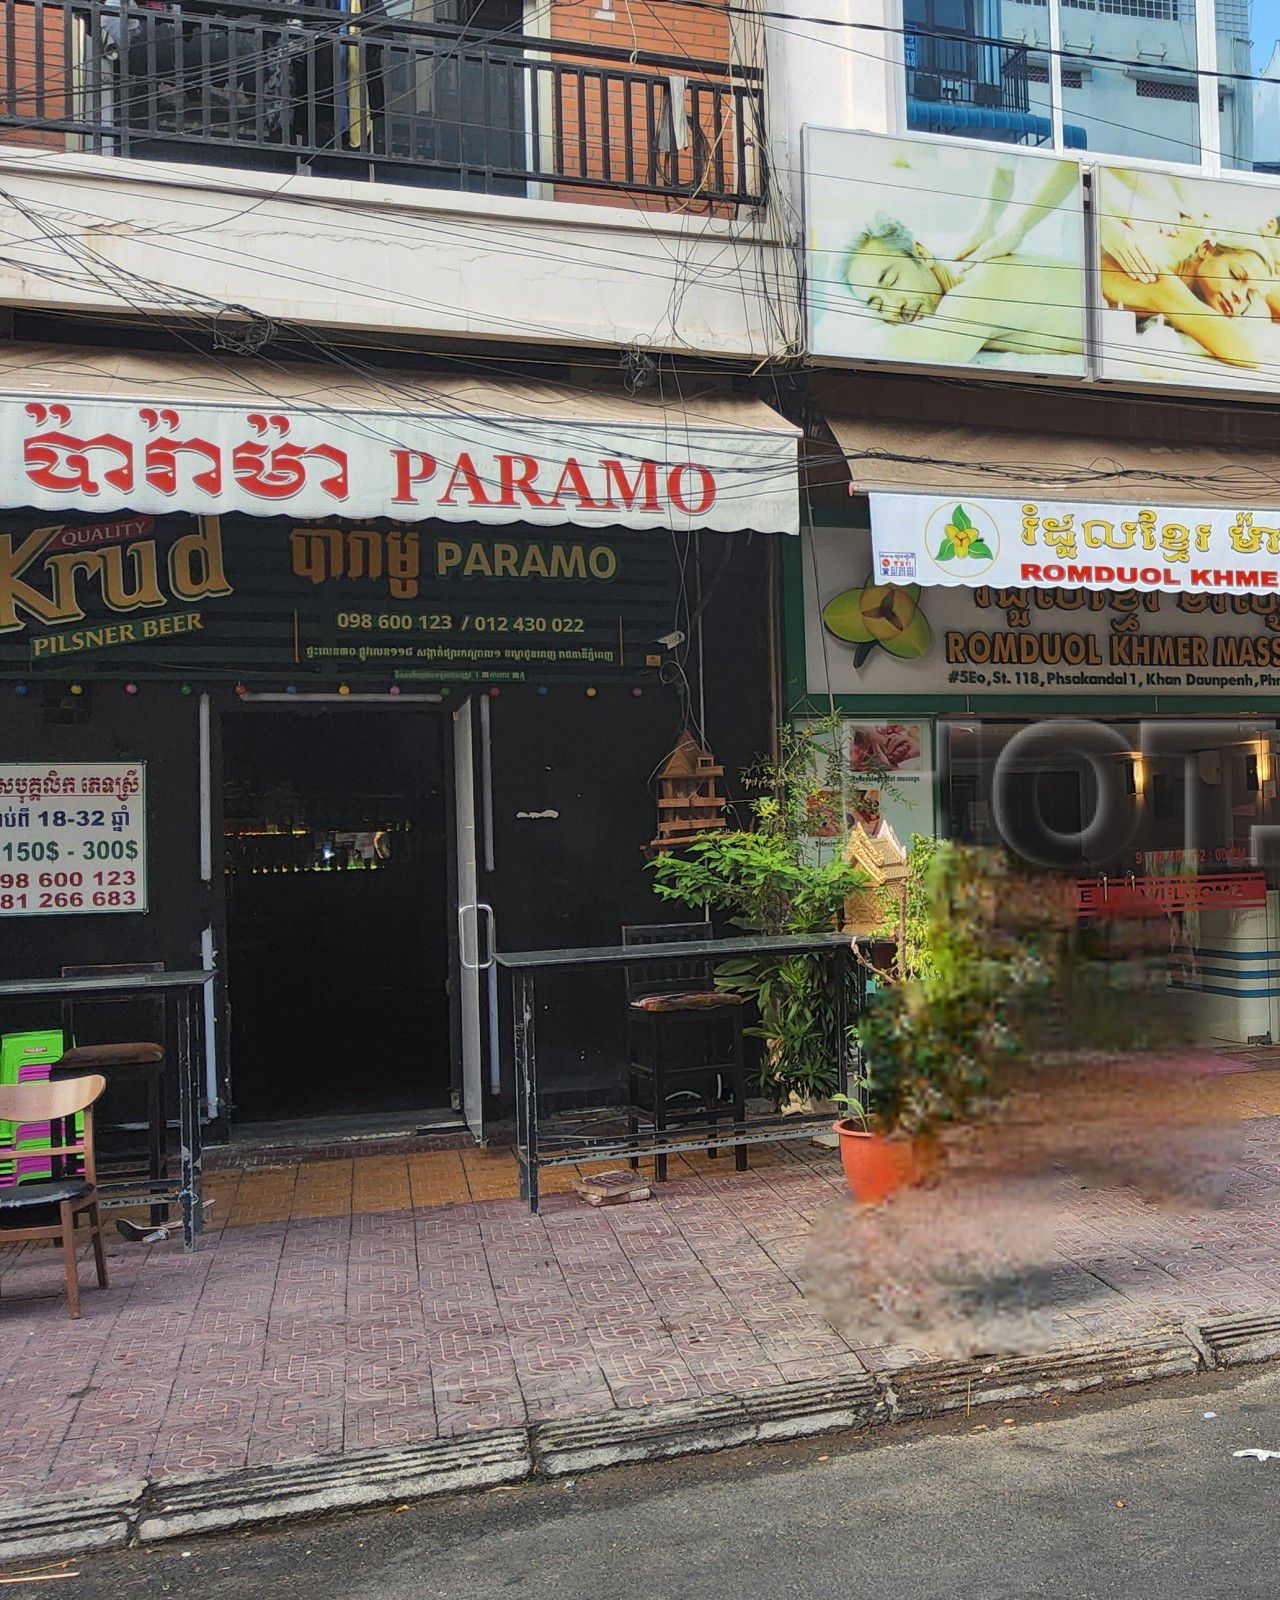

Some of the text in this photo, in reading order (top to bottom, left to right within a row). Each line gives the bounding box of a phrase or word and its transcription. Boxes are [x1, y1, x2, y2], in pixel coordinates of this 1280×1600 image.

[389, 449, 718, 517] PARAMO
[61, 520, 147, 547] QUALITY
[436, 541, 618, 579] PARAMO
[0, 514, 234, 633] Krud
[1021, 563, 1181, 586] ROMDUOL
[33, 612, 205, 657] PILSNER BEER
[337, 612, 373, 629] 098
[378, 614, 413, 630] 600
[419, 614, 452, 630] 123
[474, 616, 508, 632] 012
[513, 617, 547, 632] 430
[552, 618, 585, 633] 022
[945, 631, 1102, 667] ROMDUOL
[1110, 634, 1210, 667] KHMER
[1145, 673, 1182, 686] Khan
[38, 810, 105, 827] 18-32
[2, 840, 60, 863] 150$
[82, 838, 139, 862] 300$
[0, 870, 136, 889] 98 600 123
[0, 890, 136, 910] 81 266 683
[1140, 884, 1244, 902] WELCOME
